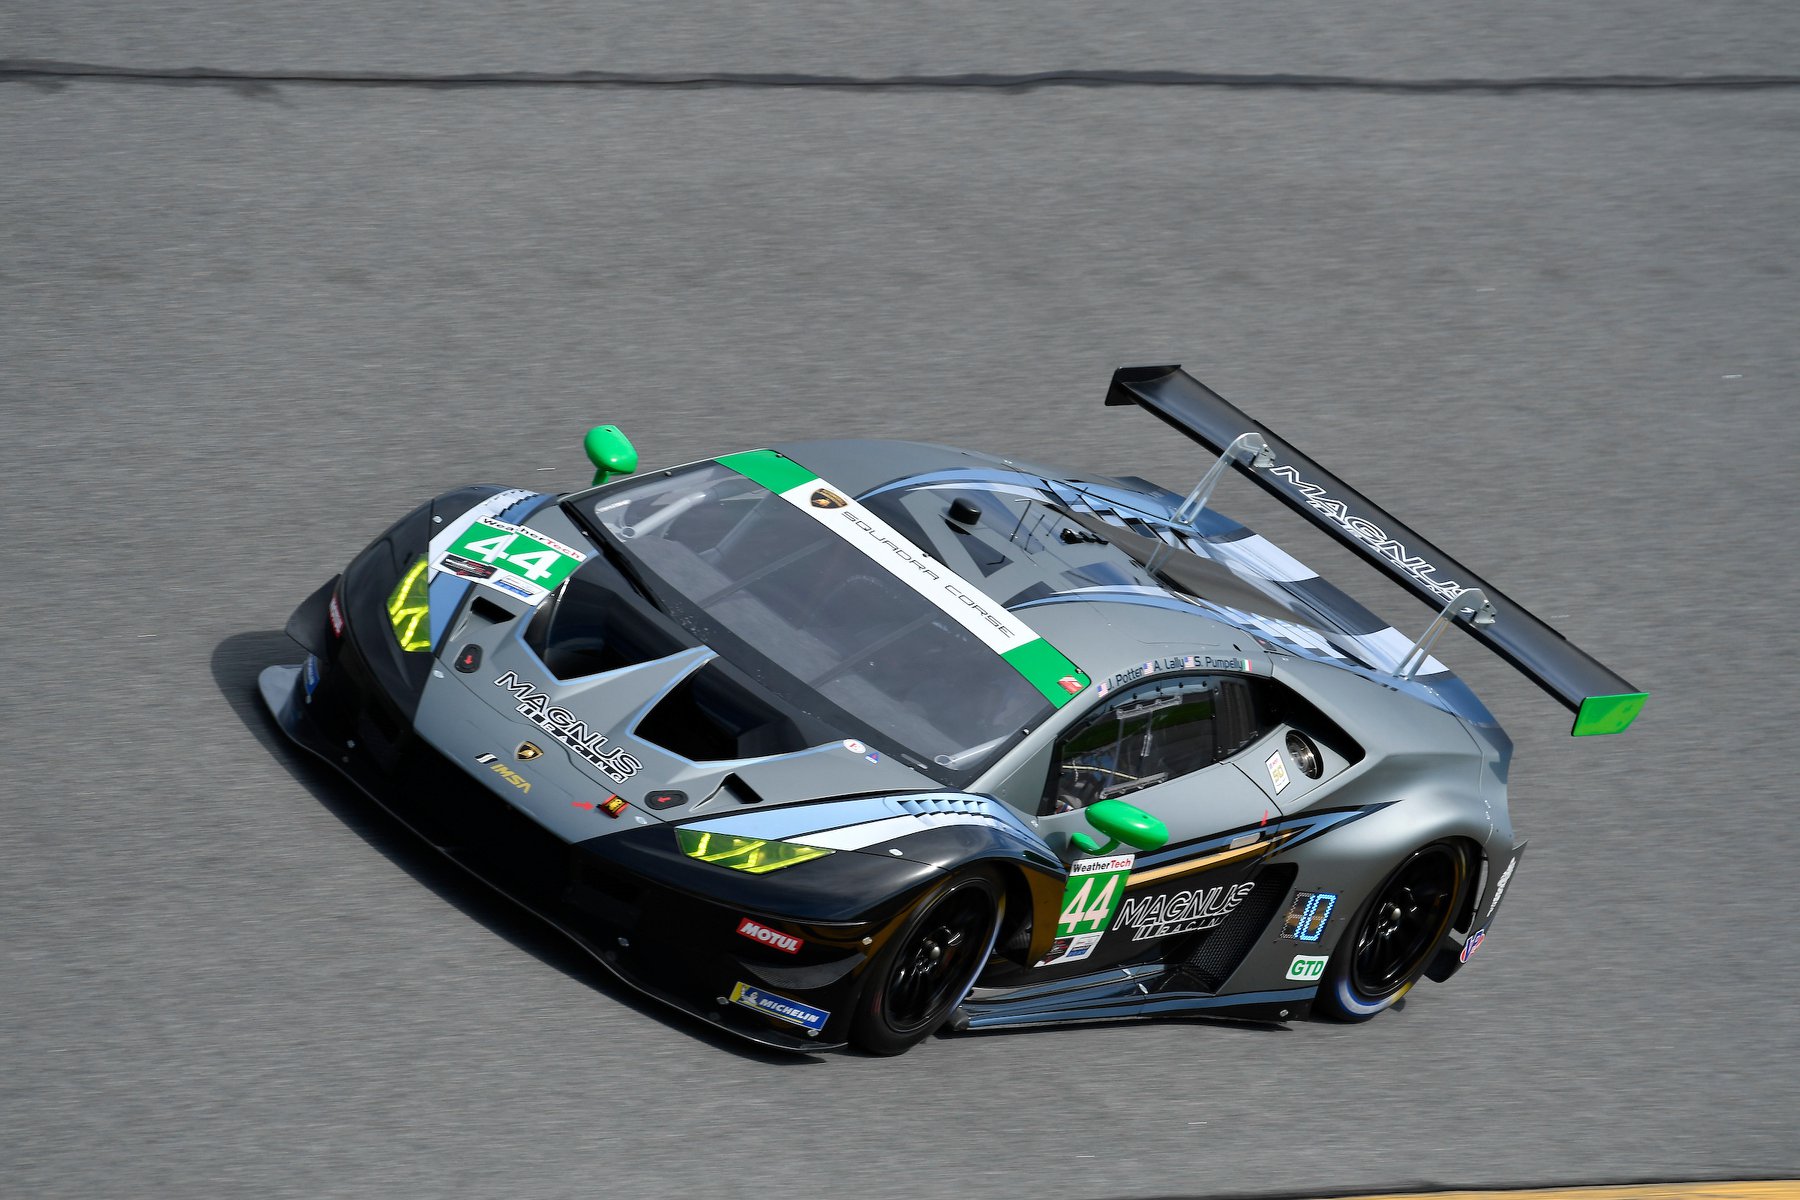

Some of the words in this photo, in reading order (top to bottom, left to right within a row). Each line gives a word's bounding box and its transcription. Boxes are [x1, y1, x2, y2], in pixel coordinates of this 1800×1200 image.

[483, 518, 581, 559] WeaherTech
[1269, 465, 1466, 603] MAGNU
[463, 533, 562, 581] 44
[841, 511, 939, 581] SQUADRA
[945, 584, 1015, 639] CORSE
[1107, 679, 1115, 690] J.
[1115, 666, 1144, 686] Potter
[1154, 661, 1163, 672] A.
[1164, 657, 1185, 671] Lally
[1194, 656, 1203, 667] S.
[1206, 657, 1243, 672] Pumpelly
[494, 670, 644, 778] MAGNUS
[542, 722, 625, 782] RACING
[490, 763, 532, 794] IMSA
[1073, 858, 1131, 872] WeatherTech
[1058, 874, 1120, 934] 44
[1112, 882, 1255, 931] MAGNUS
[740, 922, 798, 951] MOTUL
[1158, 914, 1221, 936] RACIN
[1290, 959, 1325, 977] GTD
[759, 998, 820, 1023] MICHELIN
